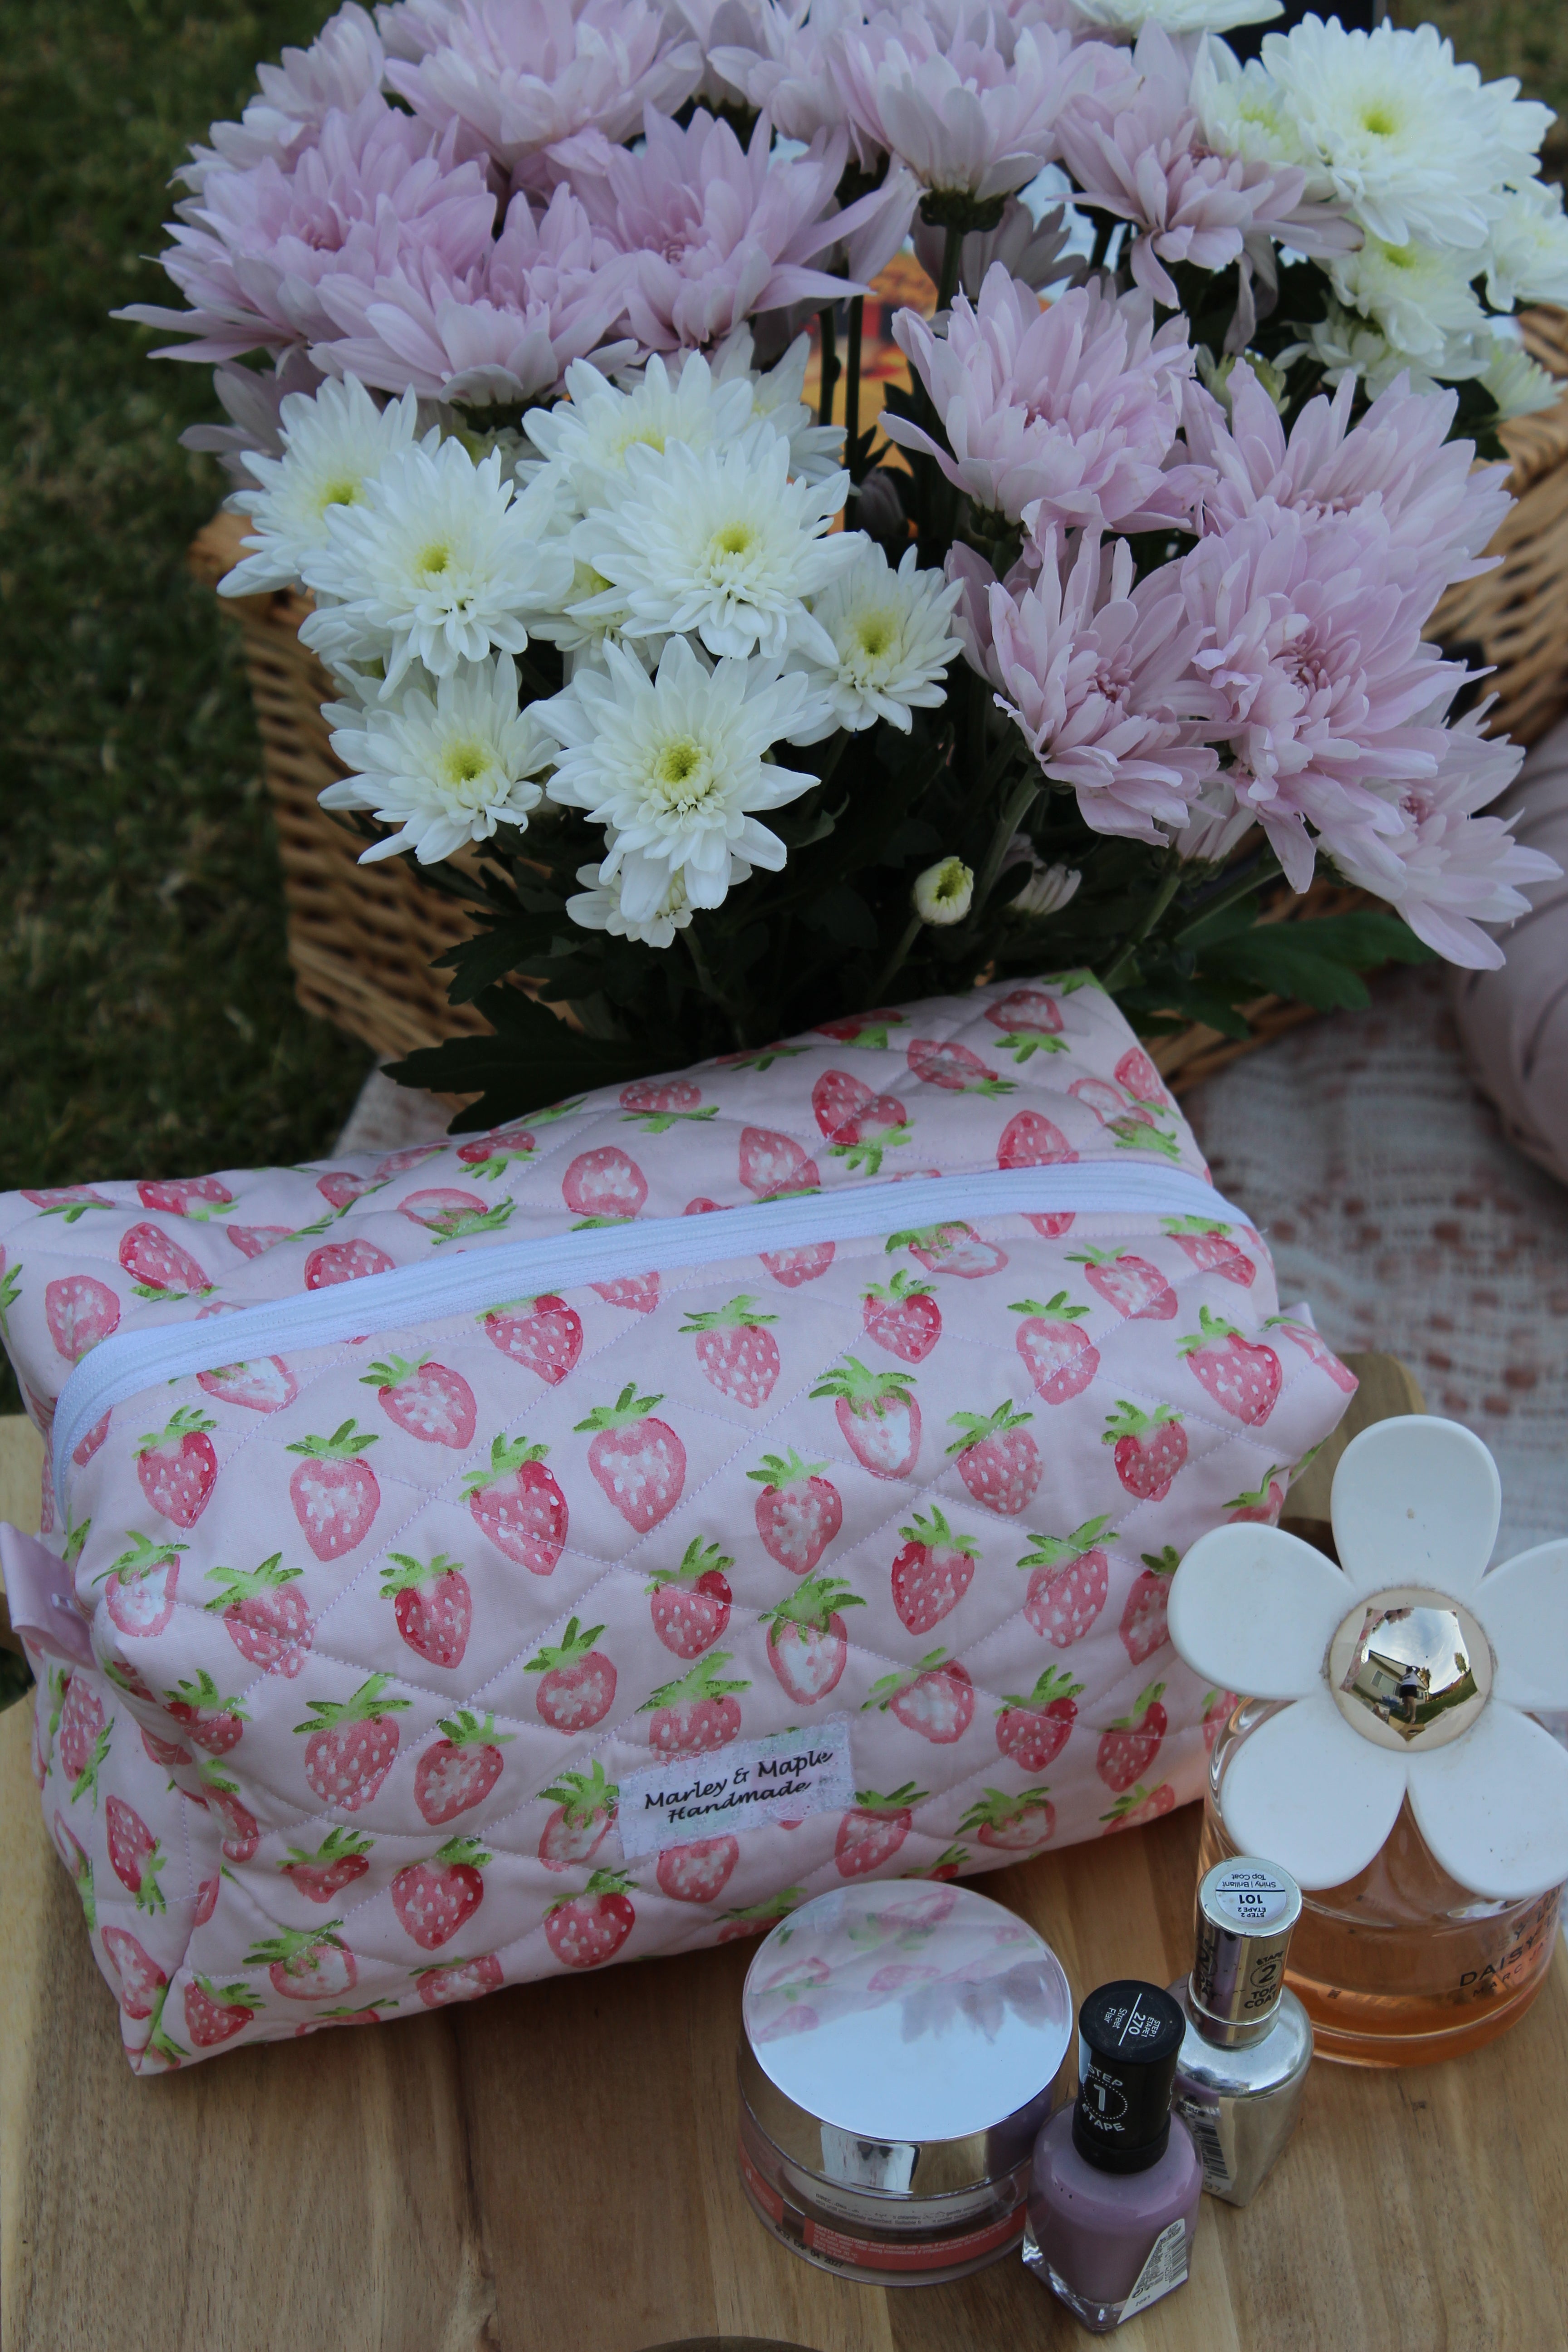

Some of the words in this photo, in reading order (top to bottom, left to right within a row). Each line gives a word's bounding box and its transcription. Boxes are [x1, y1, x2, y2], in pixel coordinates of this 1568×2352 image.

[645, 1779, 727, 1809] Marley
[733, 1768, 750, 1785] &
[758, 1750, 834, 1778] Maple
[667, 1782, 812, 1823] Handmade
[1239, 1894, 1263, 1904] 101
[1259, 1964, 1276, 1984] 2
[1245, 1989, 1277, 2009] COAT
[1251, 1984, 1277, 1999] TOP
[1104, 2008, 1116, 2024] Flair
[1112, 2008, 1127, 2029] Street
[1128, 2012, 1146, 2035] 270
[1088, 2063, 1123, 2086] STEP
[1093, 2084, 1105, 2111] 1
